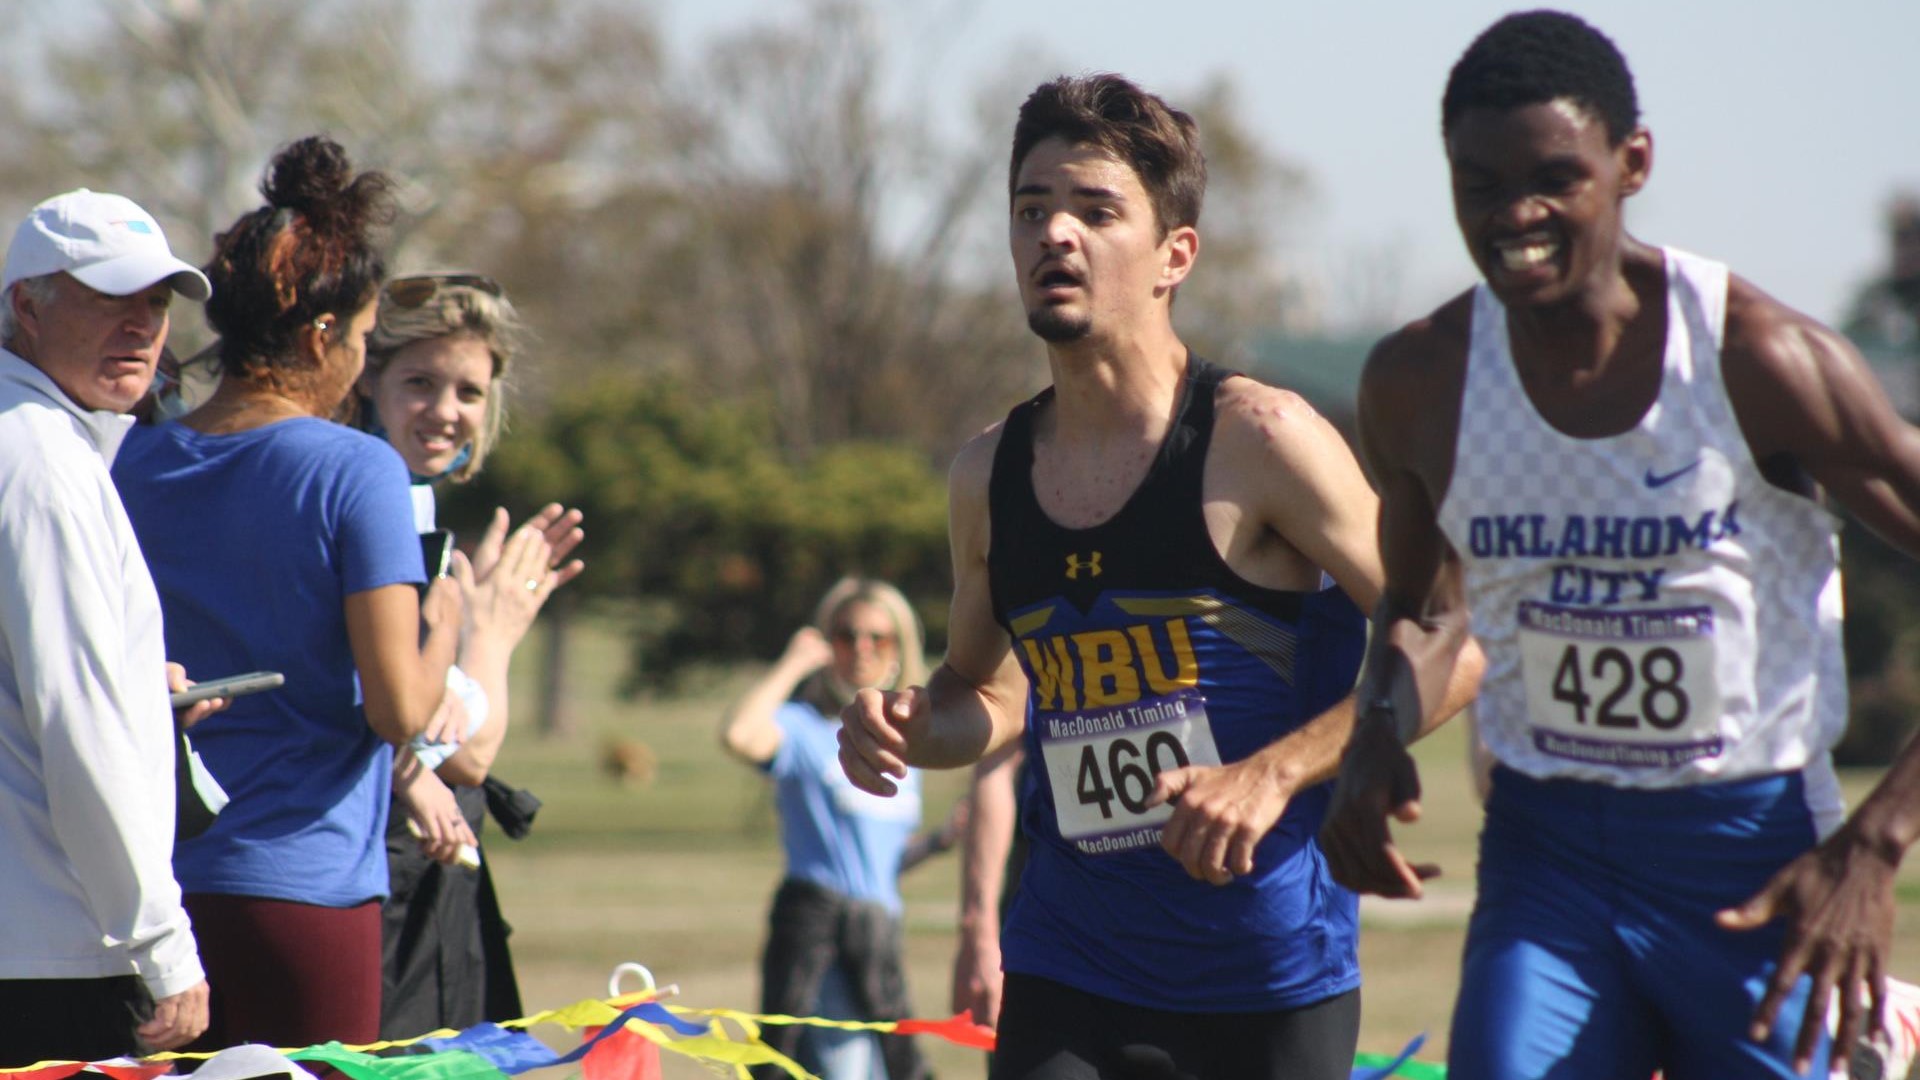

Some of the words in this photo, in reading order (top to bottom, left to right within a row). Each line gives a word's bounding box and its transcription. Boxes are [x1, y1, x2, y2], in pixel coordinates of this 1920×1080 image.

[1550, 566, 1665, 604] CITY
[1022, 618, 1198, 711] WBU
[1552, 644, 1689, 730] 428
[1049, 711, 1125, 739] MacDonald
[1128, 700, 1187, 727] Timing
[1076, 731, 1191, 820] 460
